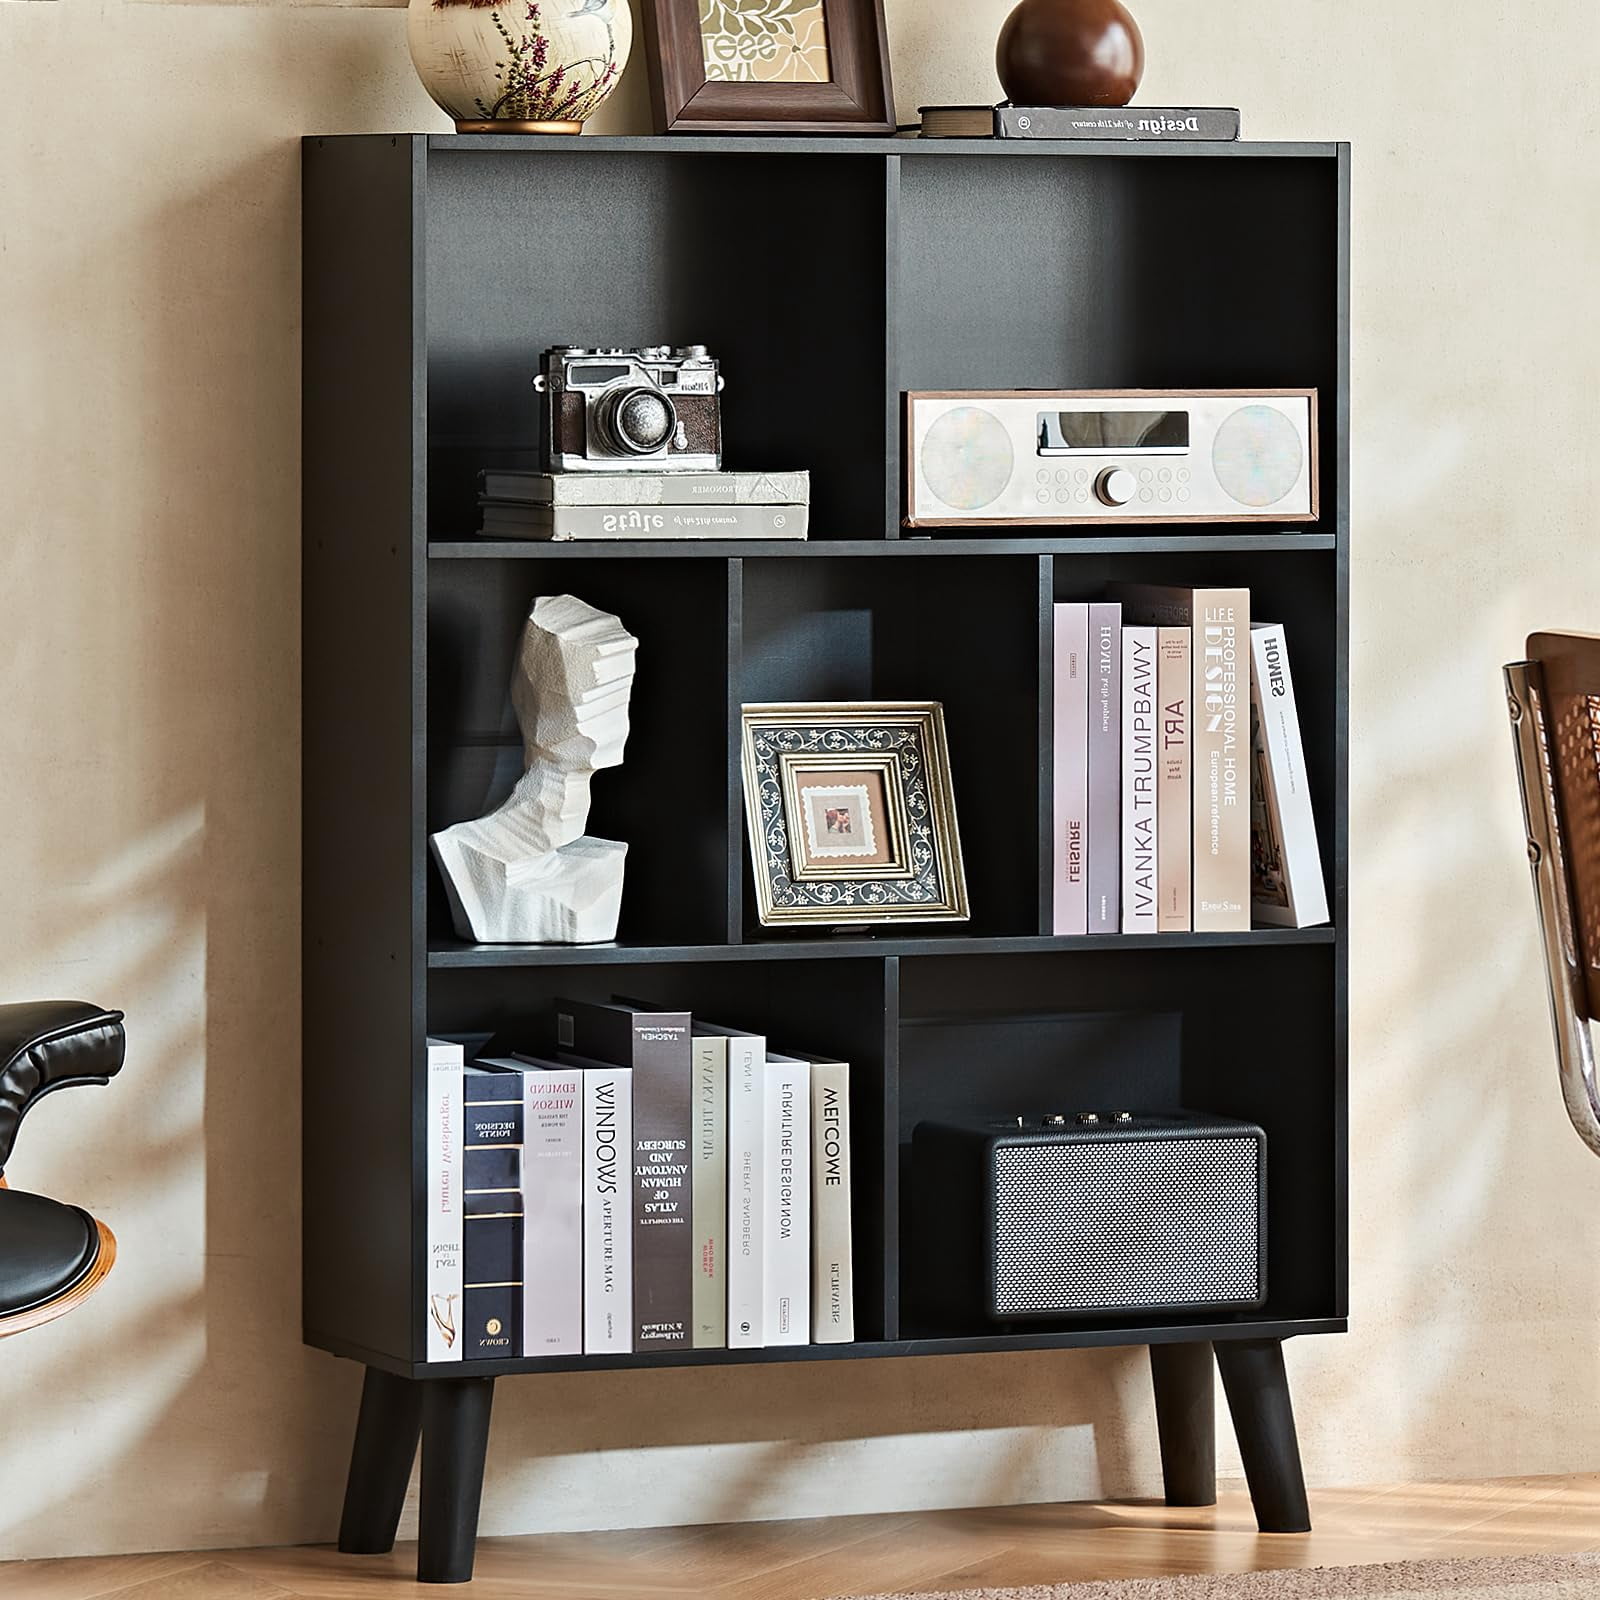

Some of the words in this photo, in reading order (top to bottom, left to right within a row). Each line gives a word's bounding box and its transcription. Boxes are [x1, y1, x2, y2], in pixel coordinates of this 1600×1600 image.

[1204, 607, 1235, 622] LIFE
[1204, 626, 1223, 733] DESIGN
[1223, 626, 1236, 754] PROFESSIONAL
[1133, 639, 1153, 810] TRUMPBAWY
[1208, 750, 1221, 802] European
[1223, 758, 1237, 807] HOME
[1209, 803, 1221, 856] reference
[1134, 817, 1154, 917] IVANKA
[641, 1033, 679, 1041] TASCHEN
[595, 1081, 617, 1194] WINDOWS
[648, 1153, 673, 1163] AND
[634, 1164, 688, 1176] ANATOMY
[640, 1177, 682, 1188] HUMAN
[644, 1202, 679, 1213] ATLAS
[653, 1190, 669, 1200] OF
[603, 1198, 614, 1262] APERTURE
[603, 1264, 614, 1293] MAG
